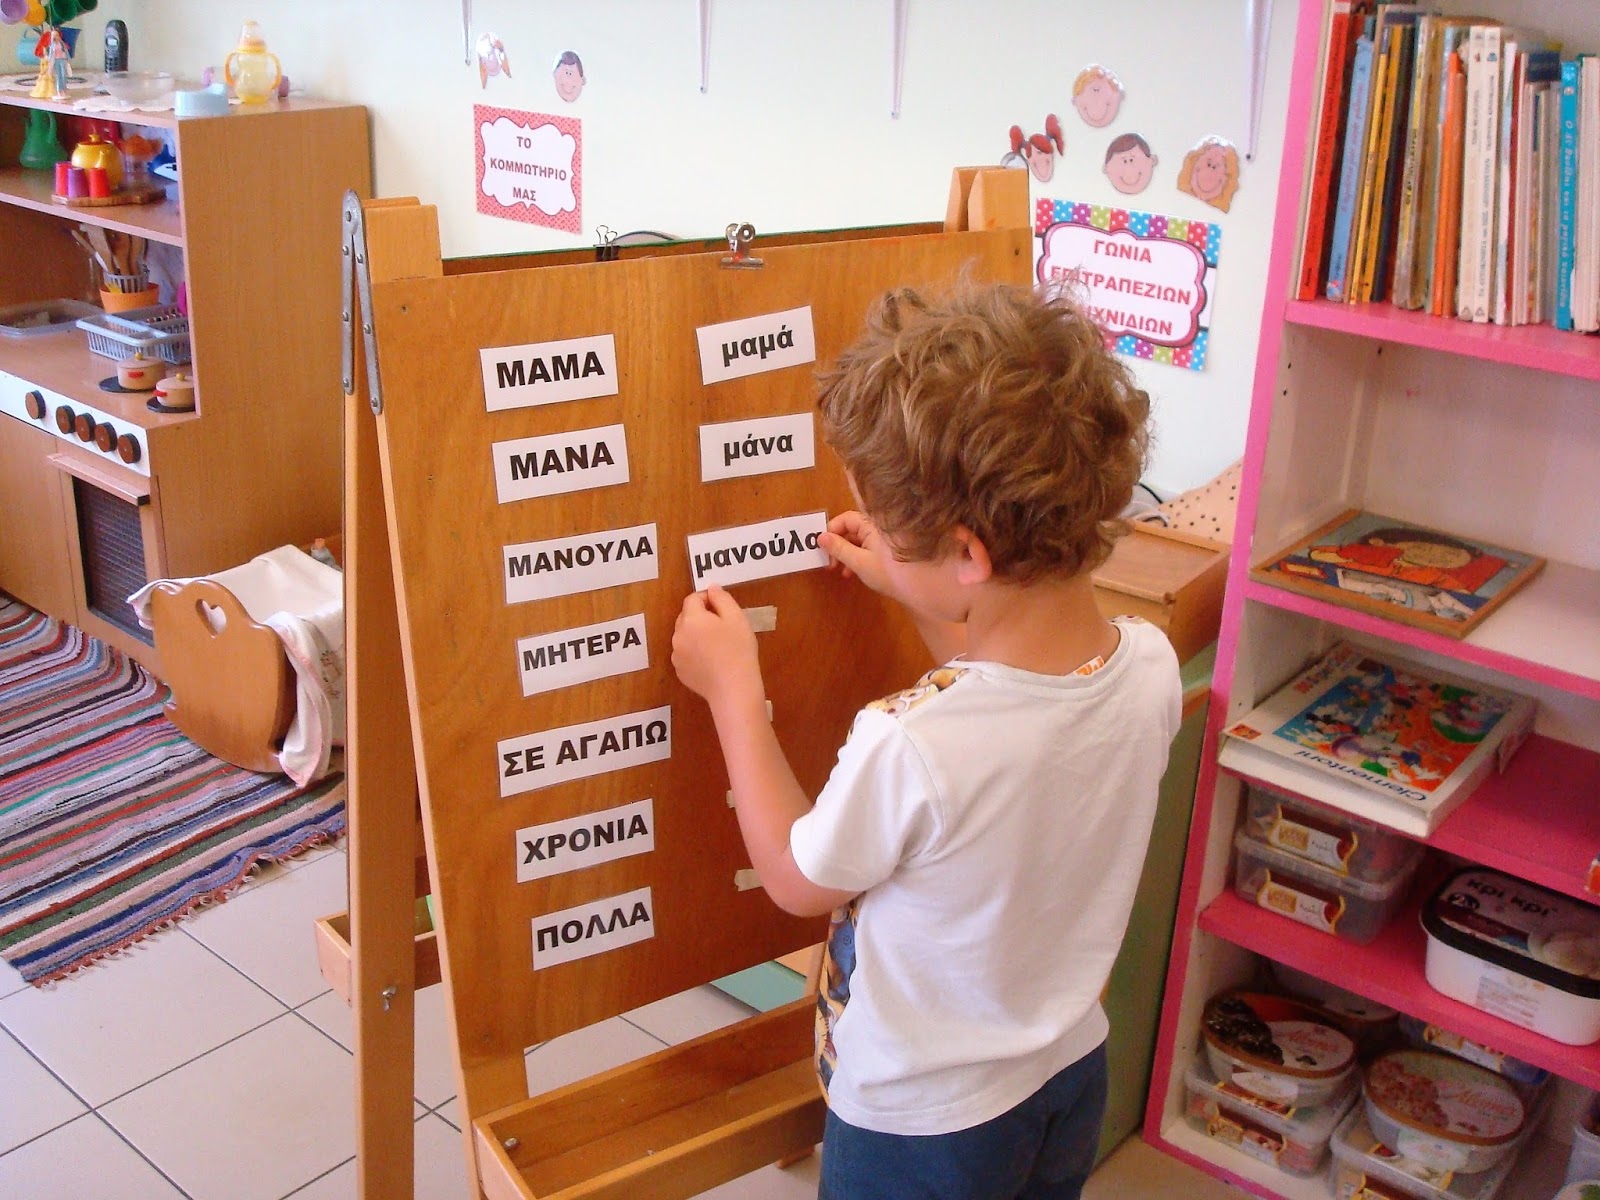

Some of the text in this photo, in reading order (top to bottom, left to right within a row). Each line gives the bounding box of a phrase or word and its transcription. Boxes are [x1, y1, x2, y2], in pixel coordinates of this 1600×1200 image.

[516, 136, 531, 148] ΤΟ
[489, 157, 567, 181] ΚΟΜΜΩΤΗΡΙΟ
[513, 187, 536, 201] ΜΑΣ
[1093, 239, 1153, 264] ΓΩΝΙΑ
[1086, 305, 1173, 336] ΙΧΝΙΔΙΩΝ
[721, 324, 795, 367] μαμά
[496, 350, 606, 390] ΜΑΜΑ
[509, 441, 615, 481] ΜΑΝΑ
[723, 433, 794, 467] μάνα
[508, 535, 654, 578] ΜΑΝΟΥΛΑ
[694, 529, 823, 579] μανούλα
[523, 626, 642, 672] ΜΗΤΕΡΑ
[502, 720, 668, 778] ΣΕ ΑΓΑΠΩ
[1293, 749, 1427, 801] Clementoni
[522, 814, 649, 865] ΧΡΟΝΙΑ
[536, 901, 651, 952] ΠΟΛΛΑ
